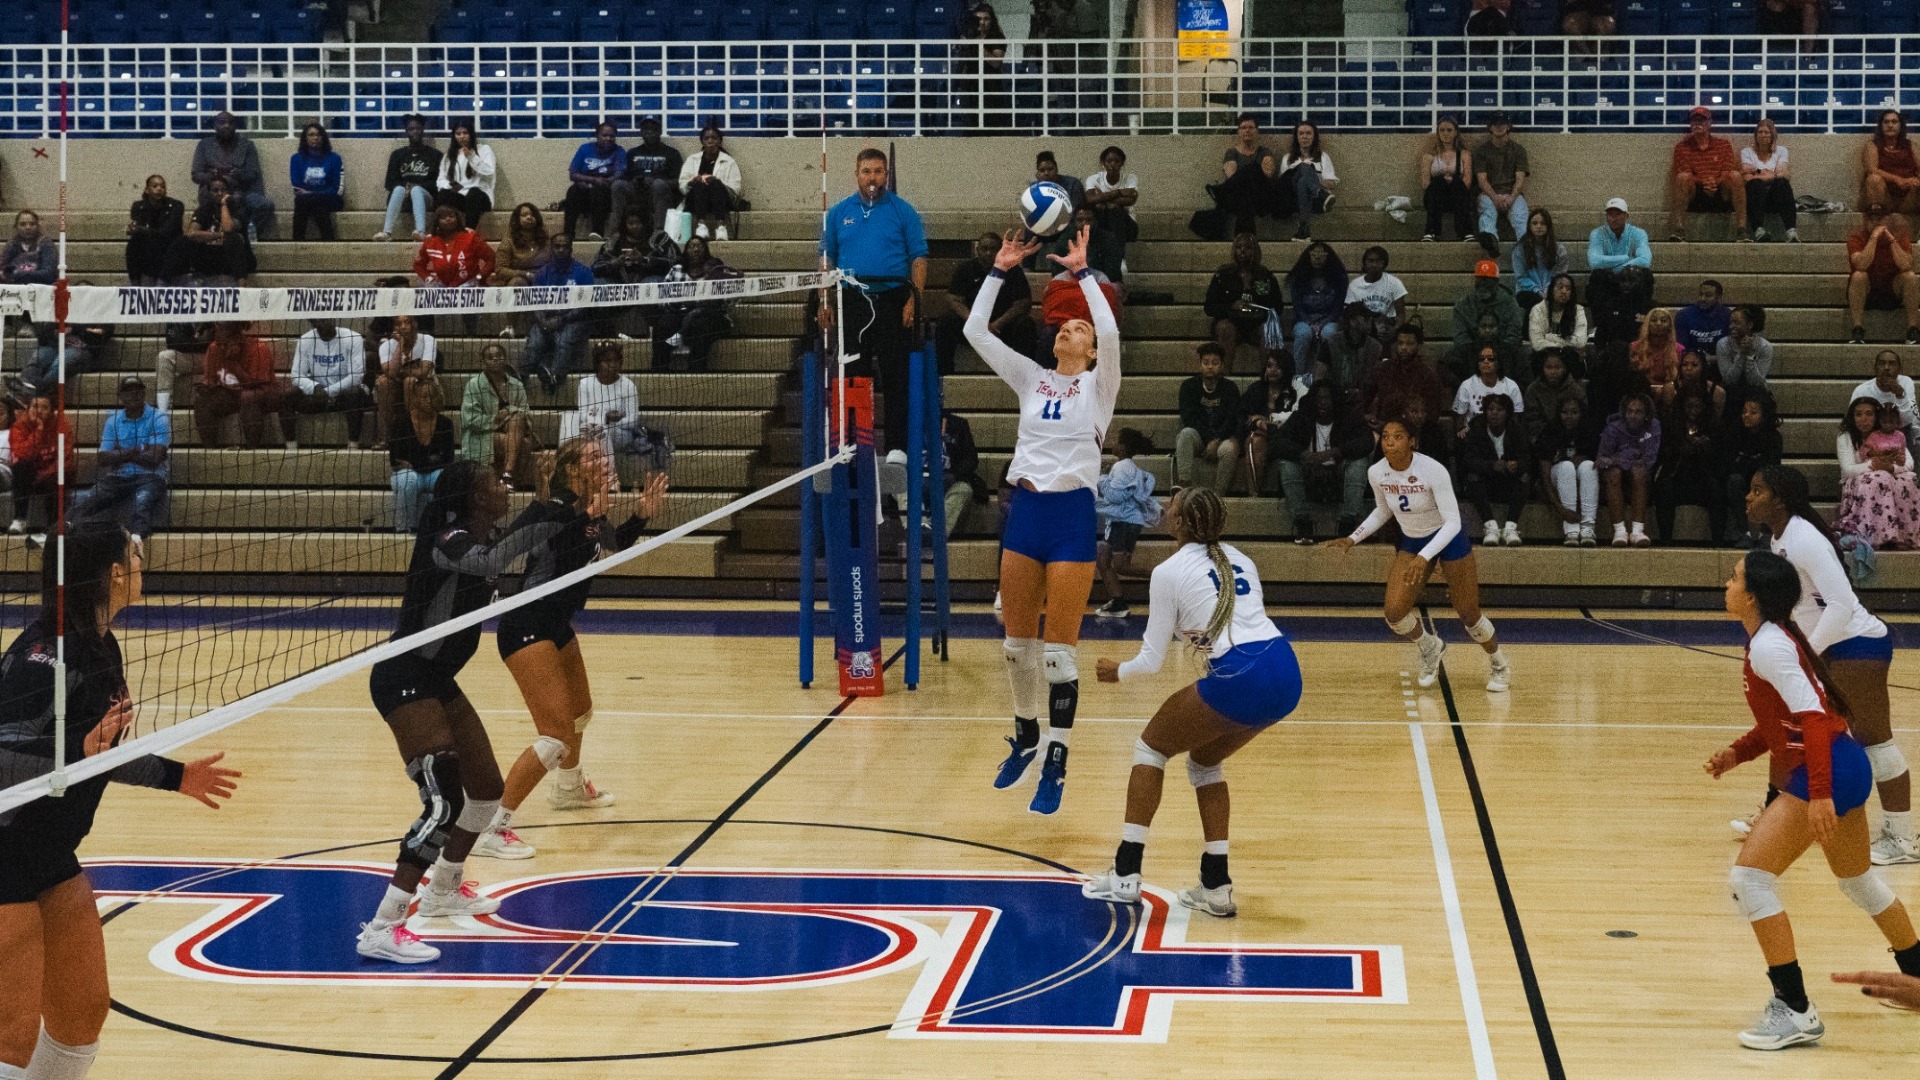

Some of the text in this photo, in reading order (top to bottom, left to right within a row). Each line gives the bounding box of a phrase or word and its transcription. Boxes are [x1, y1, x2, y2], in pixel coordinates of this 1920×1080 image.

[119, 288, 240, 315] TENNESSEE STATE
[287, 289, 378, 312] TENNESSEE STATE
[460, 288, 485, 308] STATE
[1041, 399, 1062, 420] 11
[1398, 495, 1411, 513] 2
[850, 566, 865, 643] sports imports
